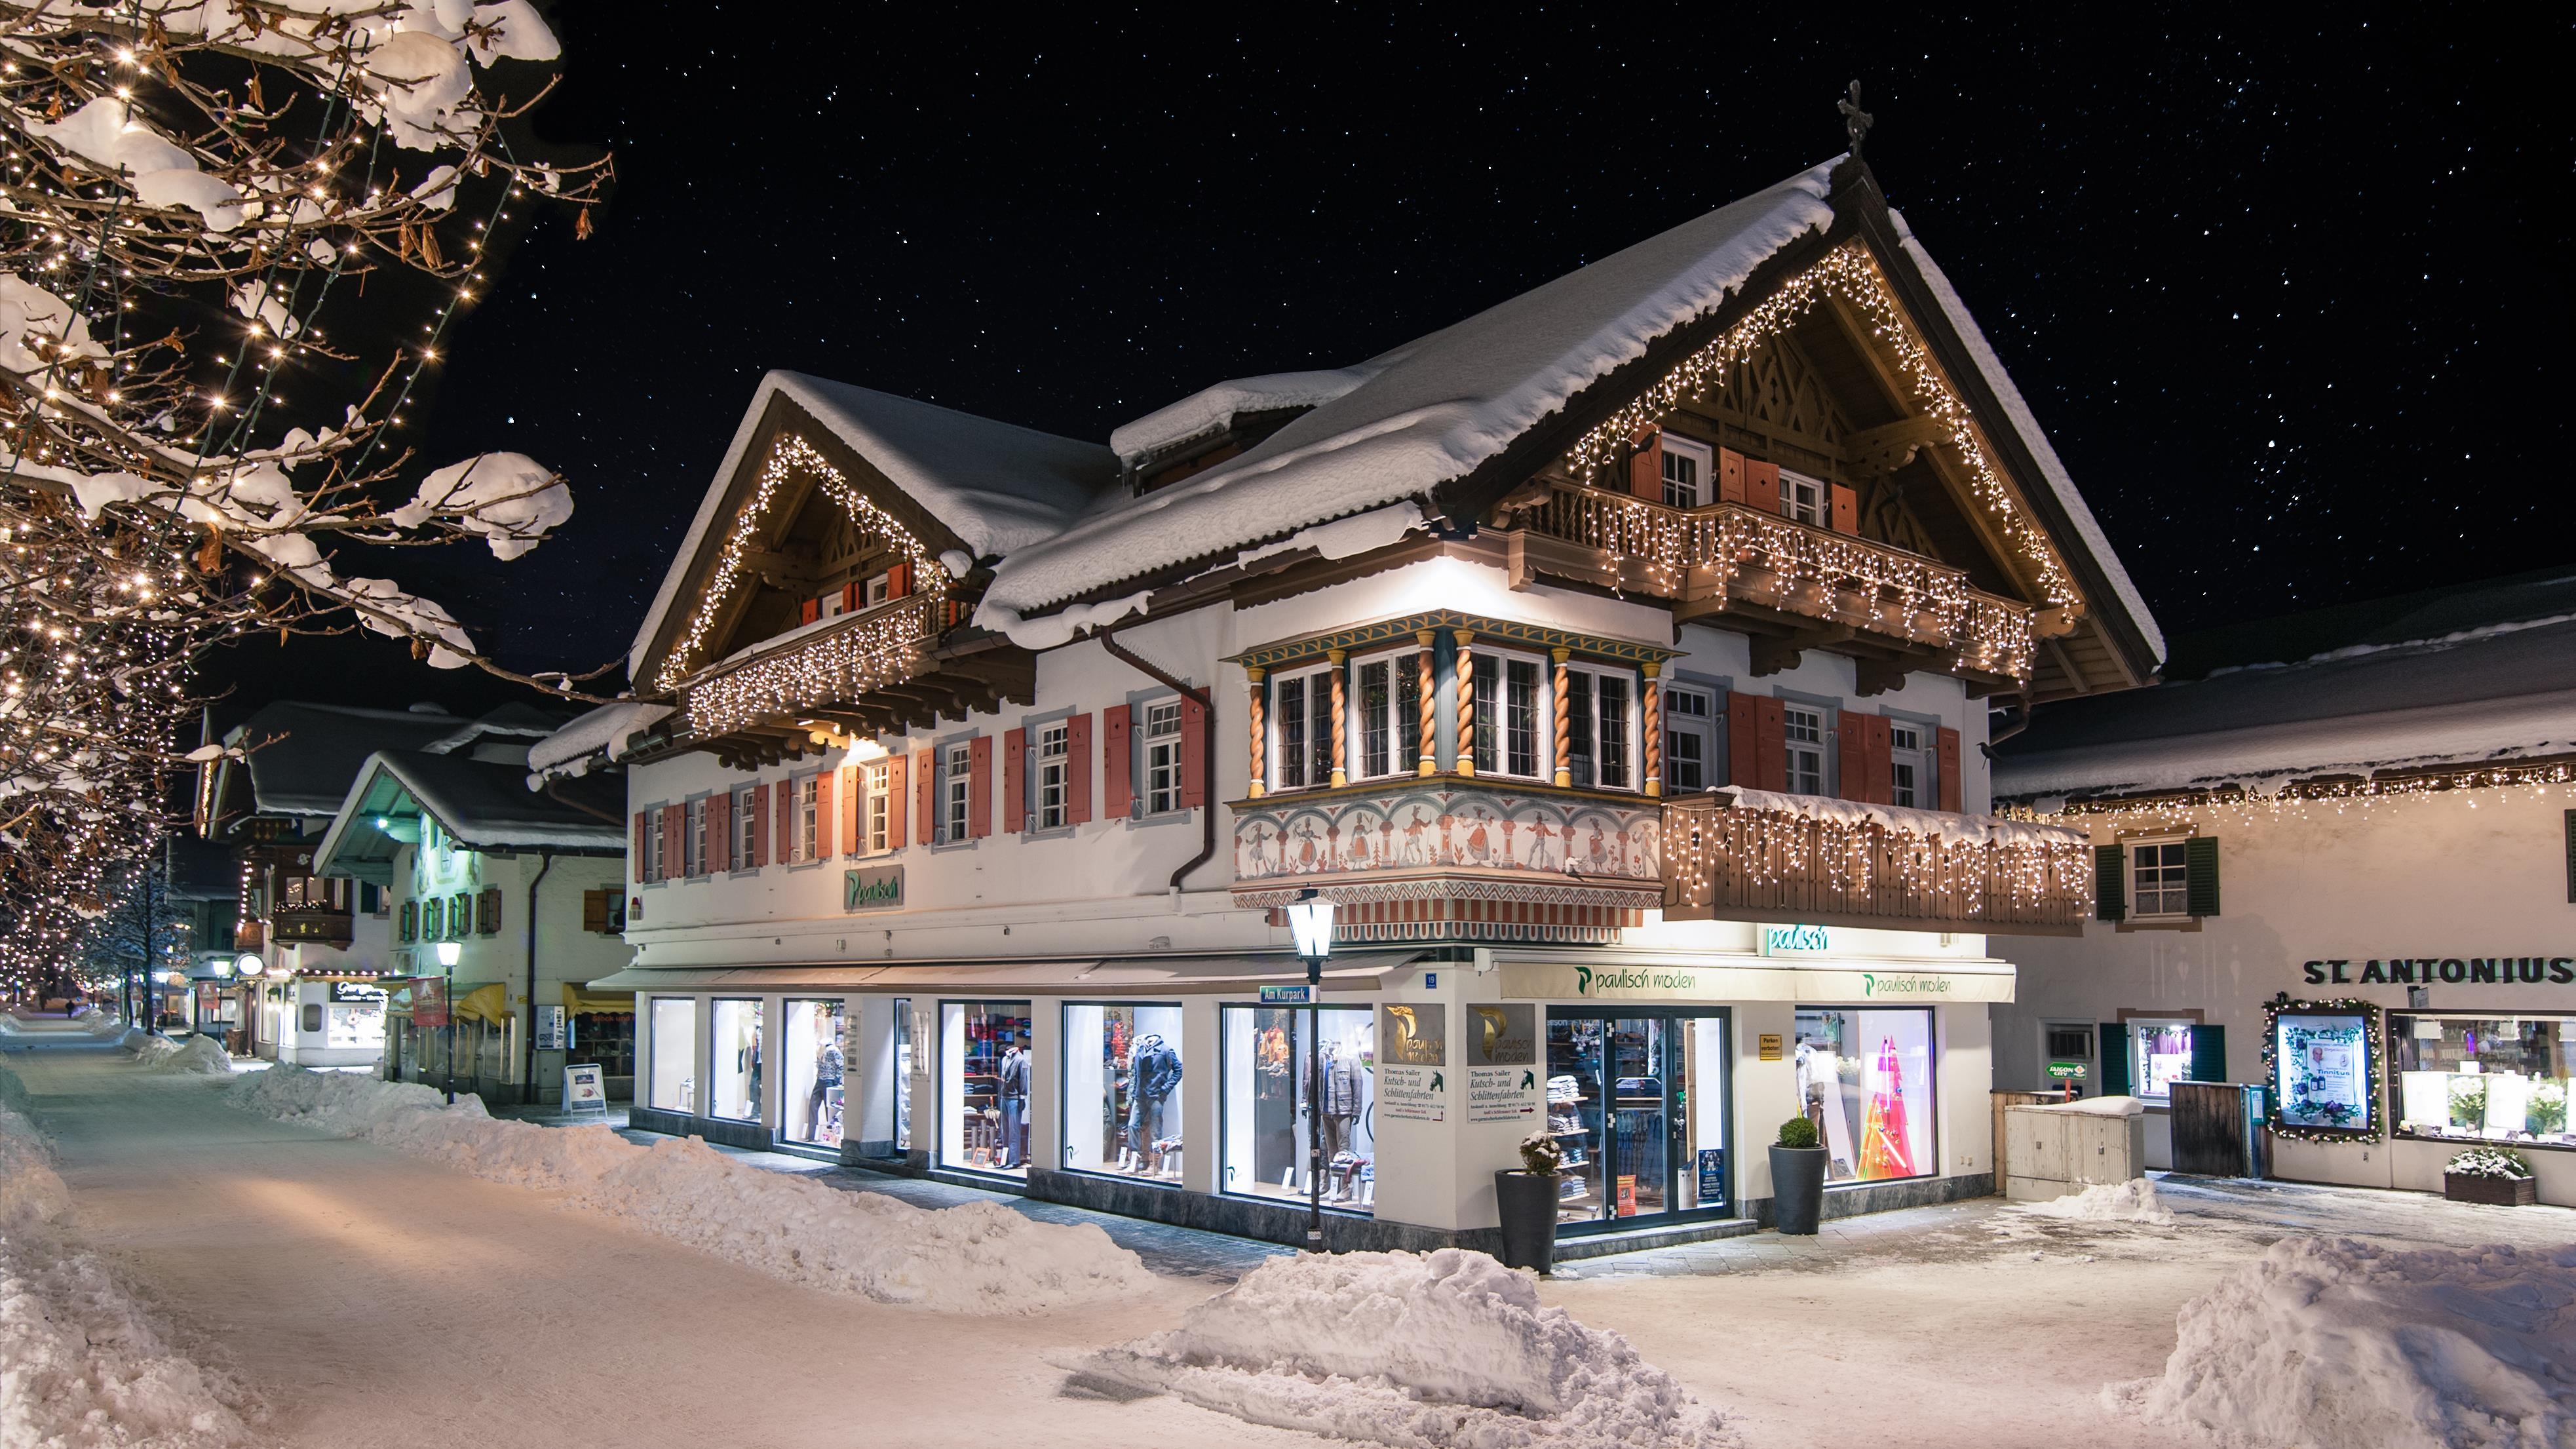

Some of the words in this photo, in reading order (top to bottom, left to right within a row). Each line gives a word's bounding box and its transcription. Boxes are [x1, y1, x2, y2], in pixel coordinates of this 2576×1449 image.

[858, 876, 898, 906] paulisch
[1767, 923, 1829, 957] paulisch
[2359, 957, 2574, 984] ANTONIUS
[1595, 968, 1649, 994] paulisch
[1653, 969, 1696, 990] moden
[1877, 975, 1917, 997] paulisch
[1919, 976, 1951, 993] moden
[1265, 989, 1275, 1000] Am
[1277, 988, 1305, 1003] Kurpark
[1406, 1038, 1442, 1052] paulh
[1495, 1050, 1529, 1062] moden
[1384, 1076, 1406, 1085] Kutsch-
[1408, 1077, 1421, 1087] und
[1470, 1077, 1495, 1089] Kutsch-
[1497, 1077, 1512, 1088] und
[1383, 1088, 1434, 1102] Schlittenfahrten
[1470, 1089, 1525, 1102] Schlittenfahrten
